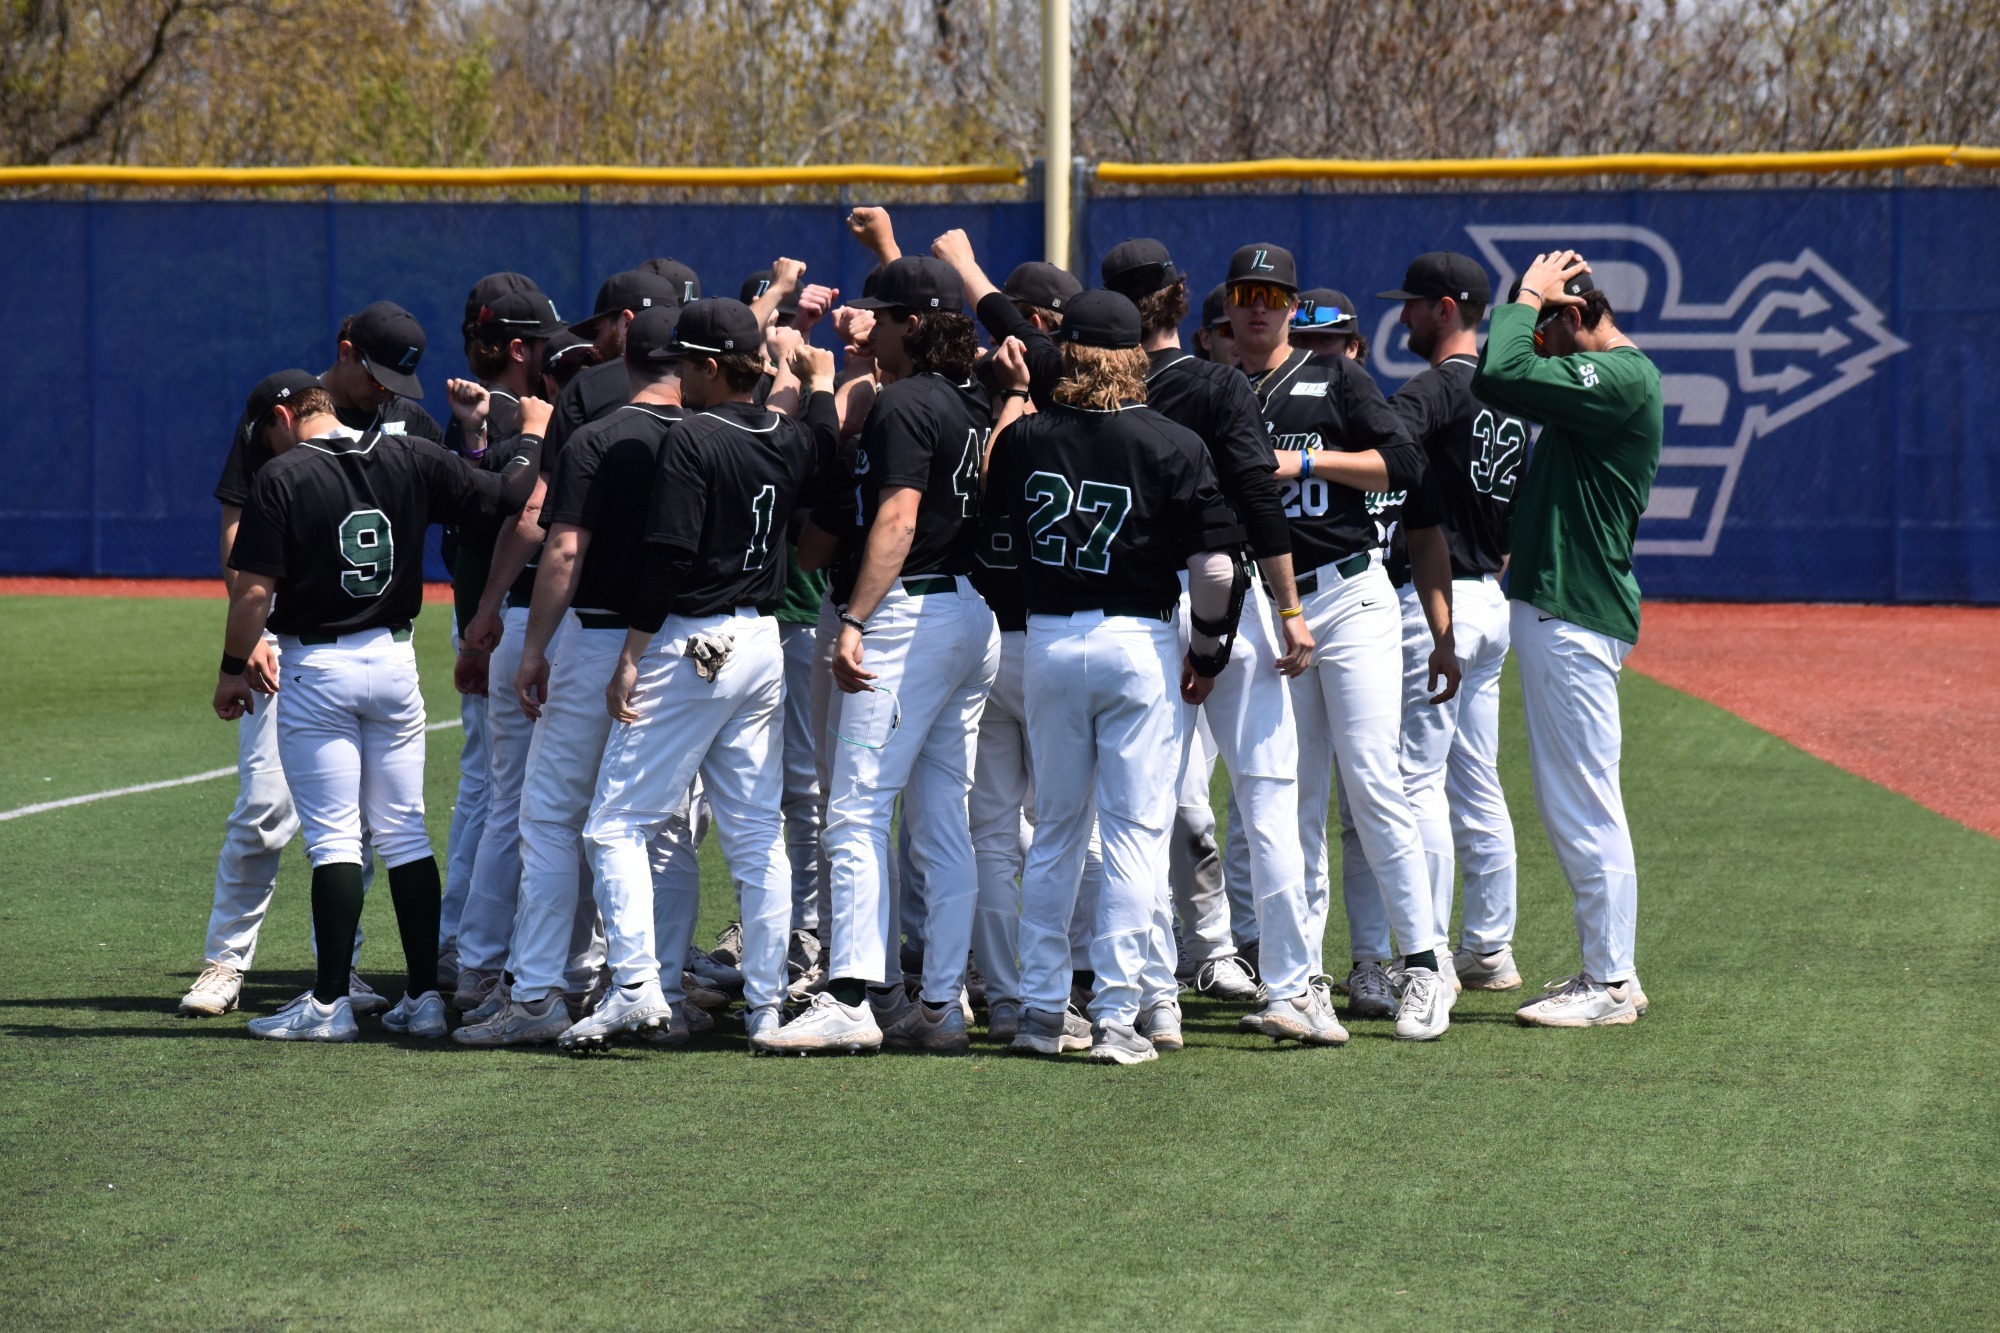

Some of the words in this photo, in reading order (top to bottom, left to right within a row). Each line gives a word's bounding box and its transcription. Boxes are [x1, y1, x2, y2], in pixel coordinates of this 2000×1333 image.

[1578, 363, 1600, 388] 35
[1275, 478, 1329, 518] 20
[1470, 408, 1526, 503] 32
[338, 508, 394, 598] 9
[742, 484, 776, 571] 1
[1024, 470, 1132, 575] 27
